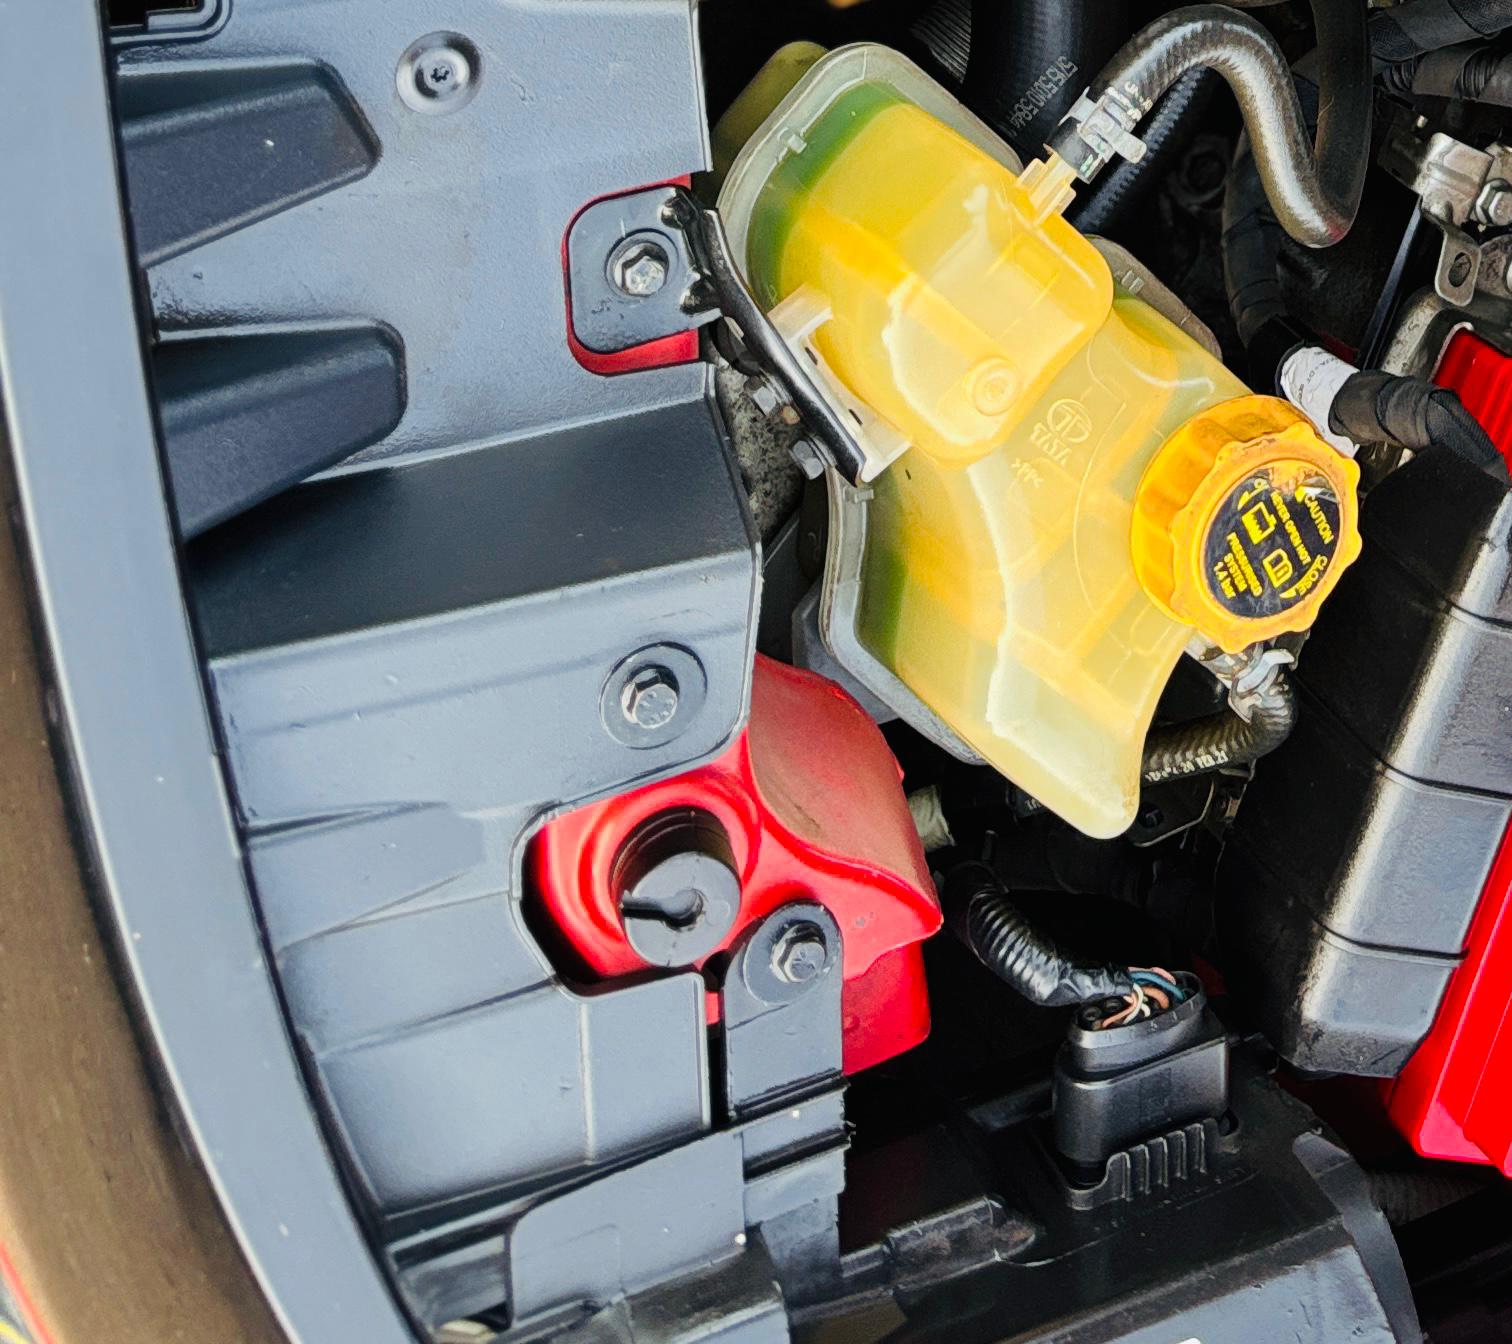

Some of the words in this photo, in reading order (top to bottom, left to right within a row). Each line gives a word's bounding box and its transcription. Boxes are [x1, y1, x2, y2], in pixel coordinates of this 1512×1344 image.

[1271, 492, 1290, 523] NEVER
[1285, 519, 1303, 548] OPEN
[1304, 494, 1335, 545] CAUTION
[1224, 552, 1248, 592] SYSTEM
[1227, 532, 1263, 597] PRESSURISED
[1296, 554, 1328, 596] CLOSE
